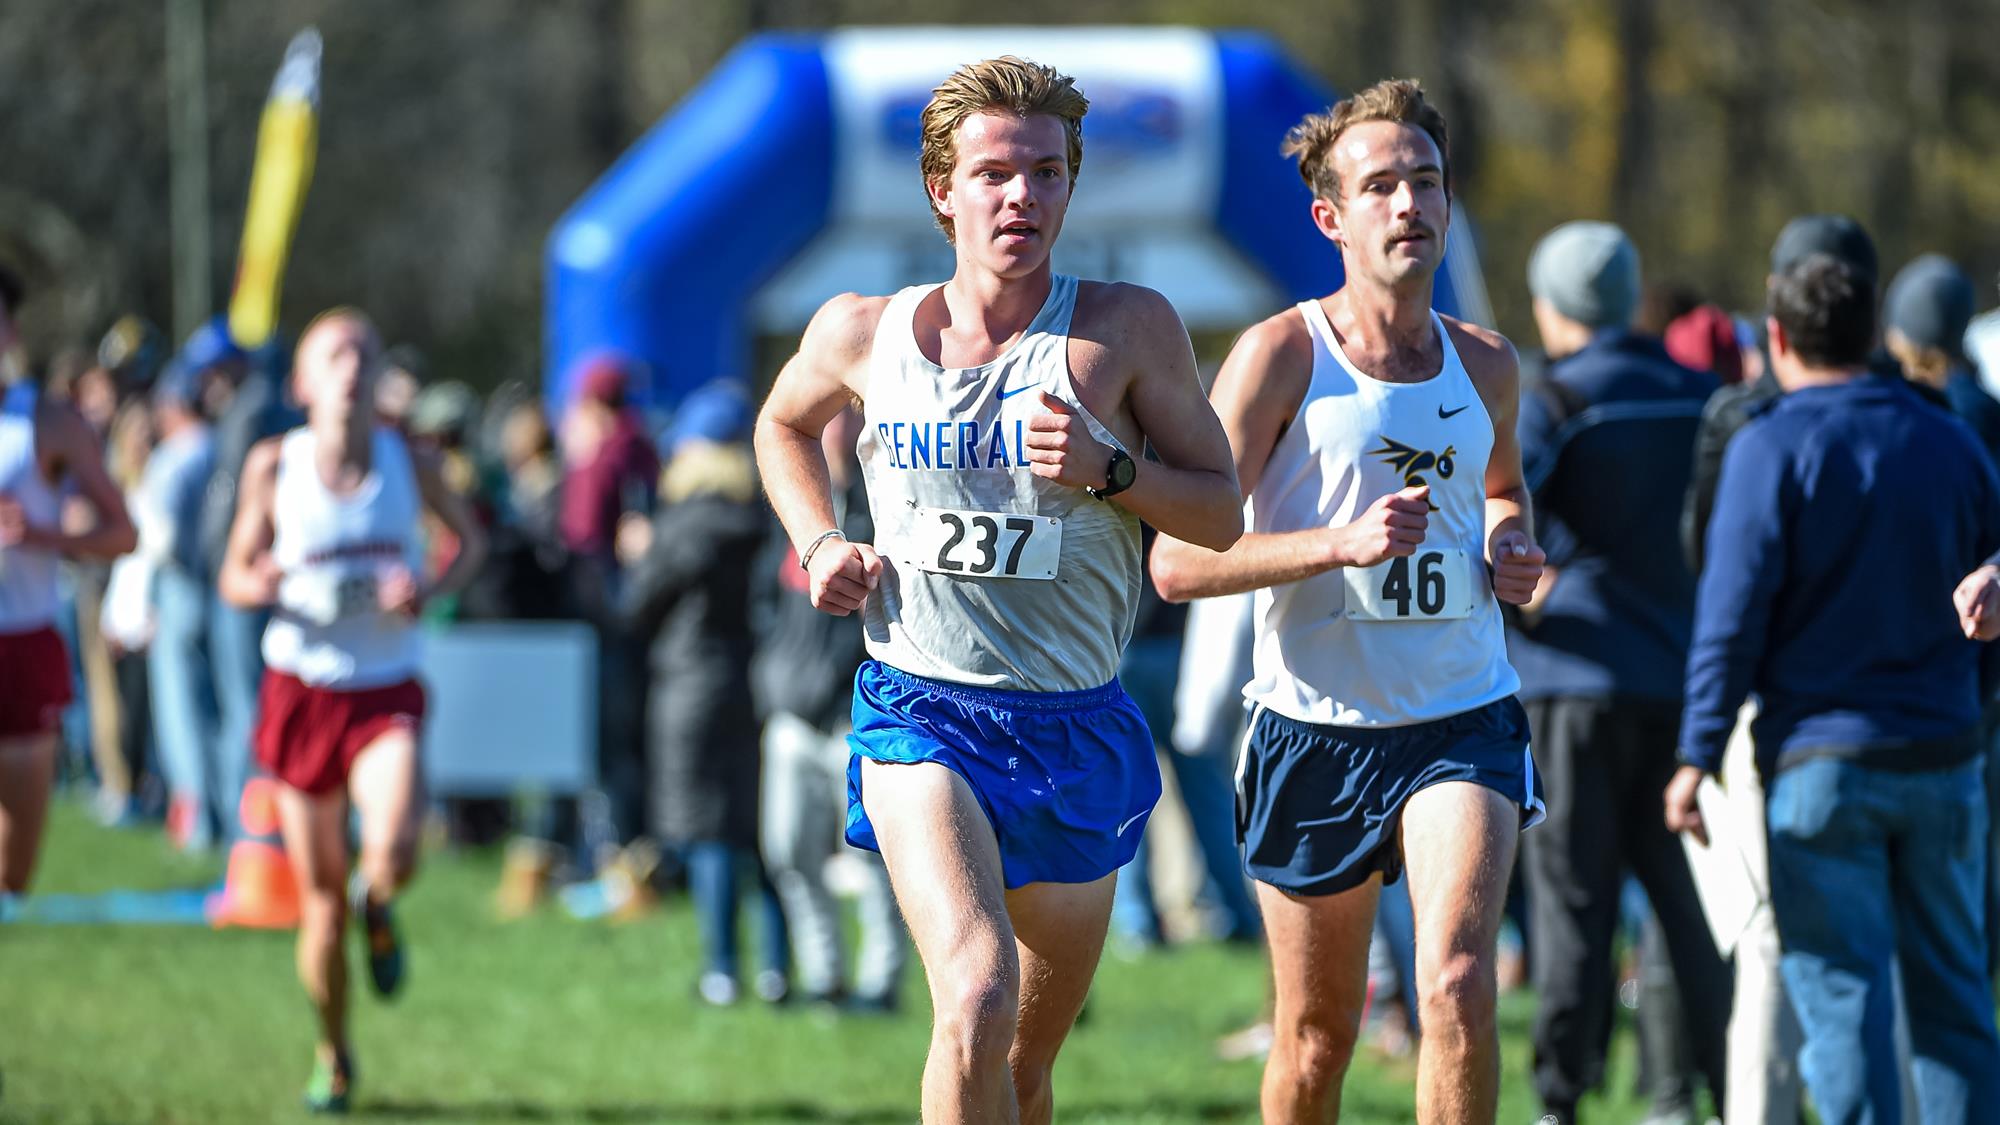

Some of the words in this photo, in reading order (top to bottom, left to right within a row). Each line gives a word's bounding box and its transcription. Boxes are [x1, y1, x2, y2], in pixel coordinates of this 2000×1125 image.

[878, 420, 1032, 470] GENERAL
[937, 513, 1034, 575] 237
[1382, 551, 1446, 616] 46
